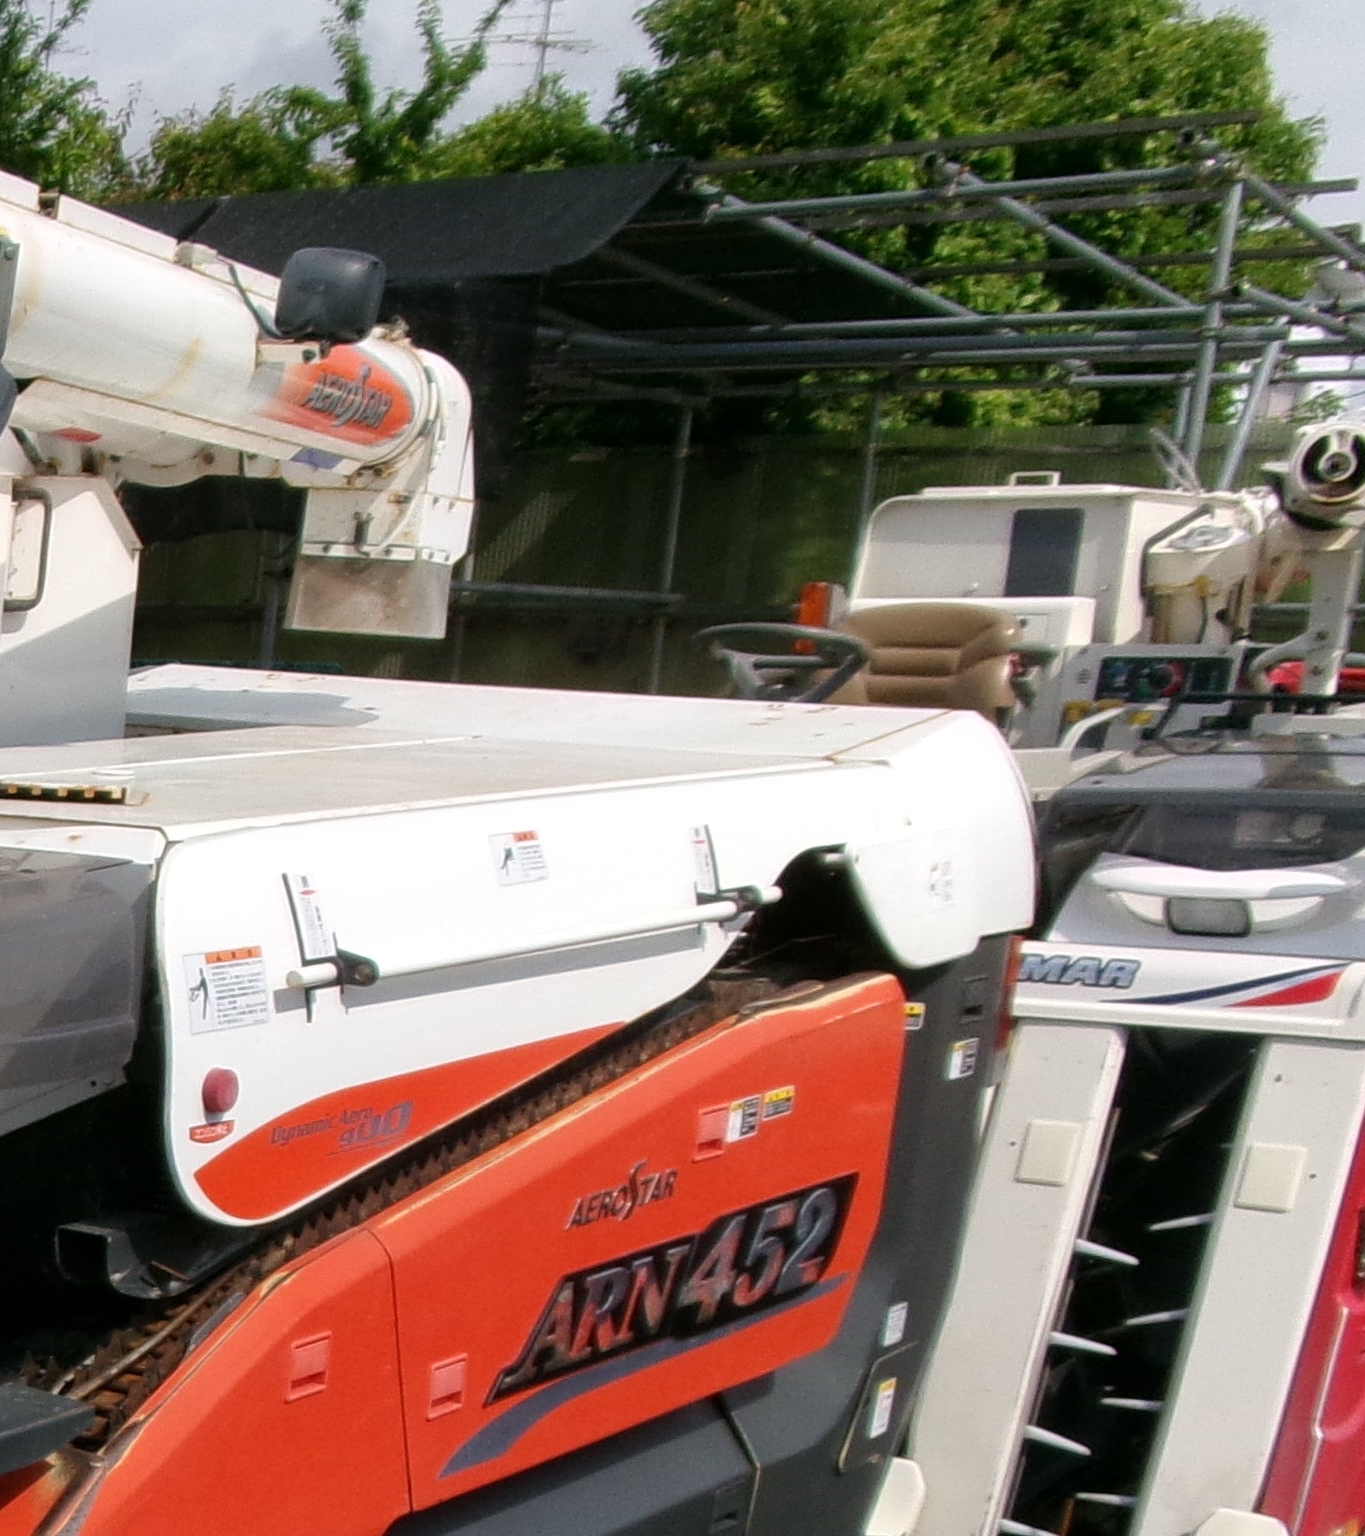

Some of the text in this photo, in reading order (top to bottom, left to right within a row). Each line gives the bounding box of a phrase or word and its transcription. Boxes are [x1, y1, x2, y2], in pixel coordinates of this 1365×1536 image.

[301, 364, 394, 429] AEROSTAR
[270, 1114, 337, 1147] Dynamic
[565, 1160, 678, 1232] AEROSTAR
